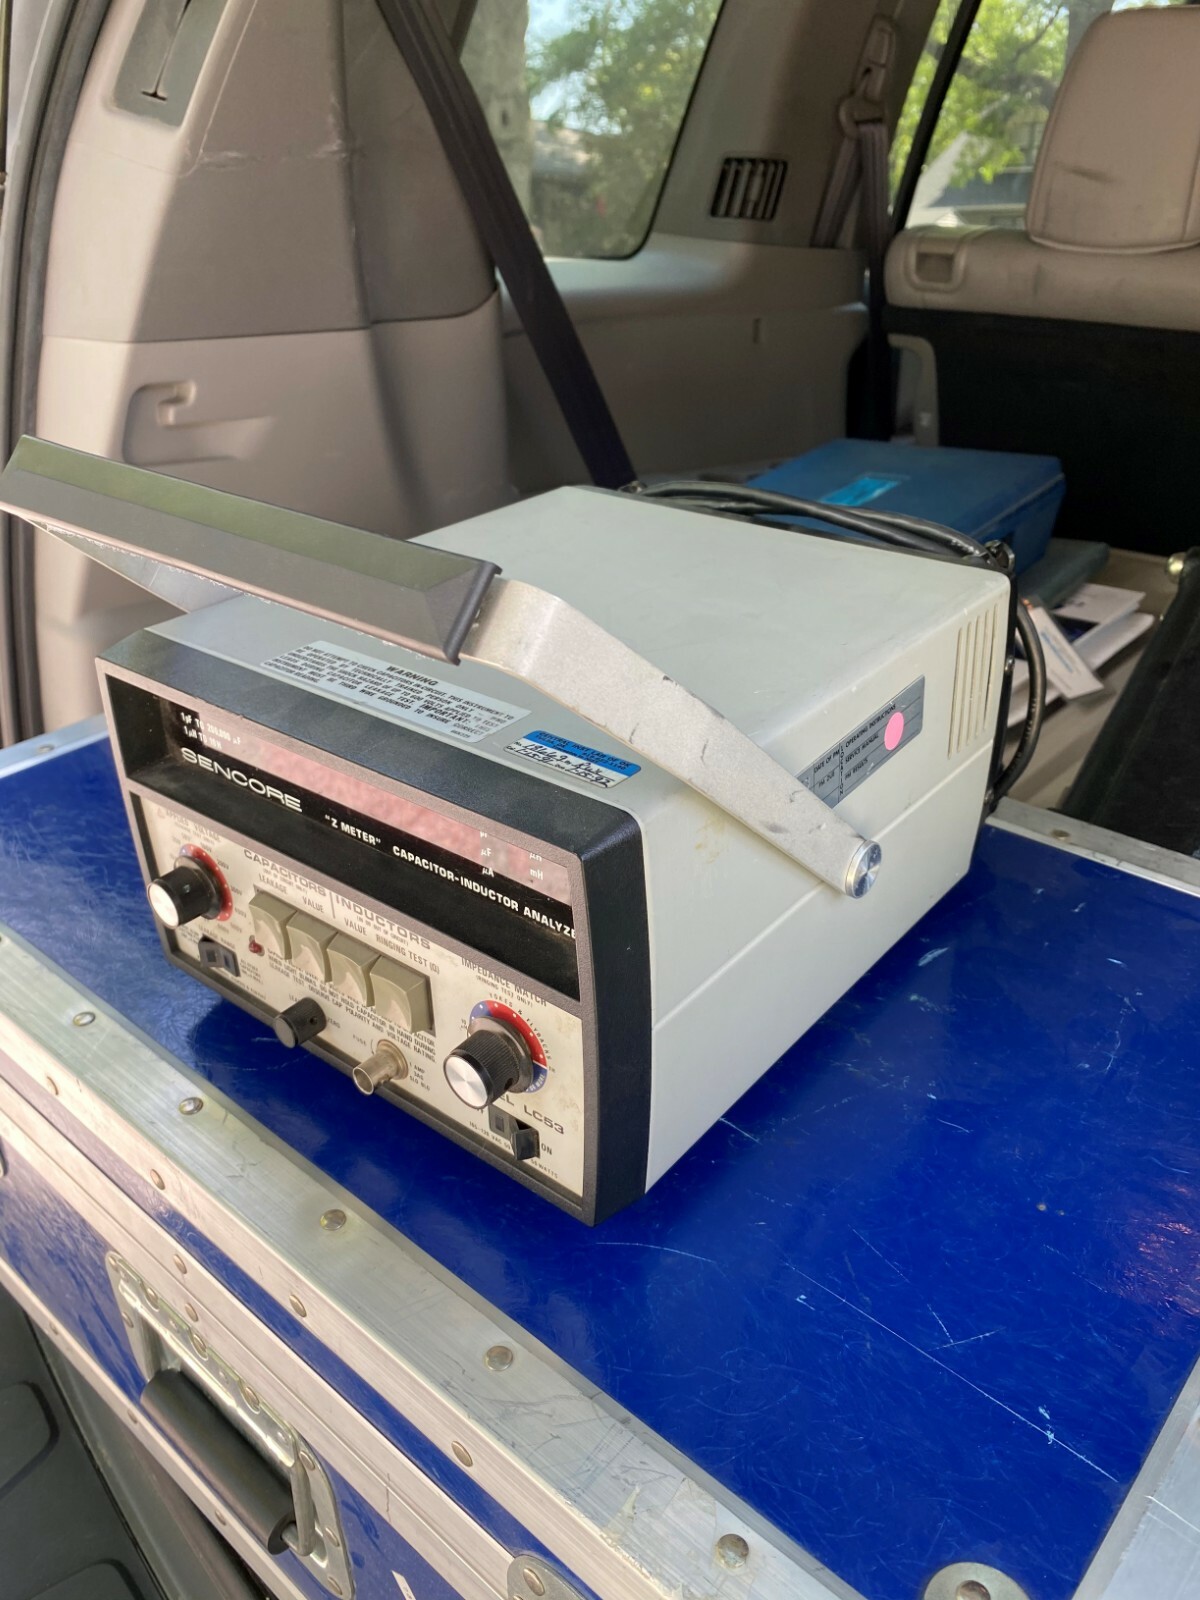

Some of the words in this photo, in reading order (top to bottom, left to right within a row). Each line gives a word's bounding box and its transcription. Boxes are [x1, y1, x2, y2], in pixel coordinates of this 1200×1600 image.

[364, 684, 393, 696] LEAKAGE
[385, 666, 439, 685] WARNING
[376, 671, 413, 684] CAPACITORS
[463, 700, 503, 716] INSTRUMENT
[395, 683, 422, 694] TRAINED
[426, 694, 451, 704] PERSON
[455, 704, 474, 712] ONLY
[423, 699, 443, 708] VOLTS
[445, 707, 471, 717] APPLIED
[195, 718, 205, 730] TO
[378, 696, 411, 709] GROUNDED
[426, 713, 450, 723] INSURE
[453, 723, 483, 735] CORRECT
[846, 726, 868, 748] OPERATING
[869, 703, 896, 729] INSTRUCTIONS
[198, 732, 208, 743] TO
[813, 762, 825, 774] DATE
[825, 755, 832, 764] OF
[832, 749, 840, 759] PM
[845, 747, 860, 764] SERVICE
[181, 747, 302, 812] SENCORE
[480, 847, 491, 857] µF
[243, 848, 326, 897] CAPACITORS
[392, 845, 519, 912] CAPACITOR-INDUCTOR
[482, 867, 494, 877] µA
[530, 869, 543, 880] mH
[259, 873, 287, 894] LEAKAGE
[302, 895, 324, 913] VALUE
[336, 895, 431, 950] INDUCTORS
[344, 917, 367, 936] VALUE
[376, 934, 406, 957] RINGING
[408, 950, 427, 968] TEST
[461, 958, 511, 989] IMPEDANCE
[514, 983, 547, 1007] MATCH
[476, 975, 499, 990] (RINGING
[501, 988, 514, 999] TEST
[516, 995, 533, 1008] ONLY)
[331, 997, 343, 1009] CAP
[344, 1005, 370, 1024] POLARITY
[372, 1020, 383, 1032] AND
[387, 1029, 411, 1048] VOLTAGE
[356, 1005, 386, 1026] CAPACITOR
[388, 1023, 394, 1031] IN
[396, 1028, 412, 1041] HAND
[414, 1038, 435, 1055] DURING
[414, 1064, 425, 1074] AMP
[414, 1070, 424, 1081] 3AG
[523, 1104, 564, 1135] LC53
[541, 1143, 553, 1155] ON
